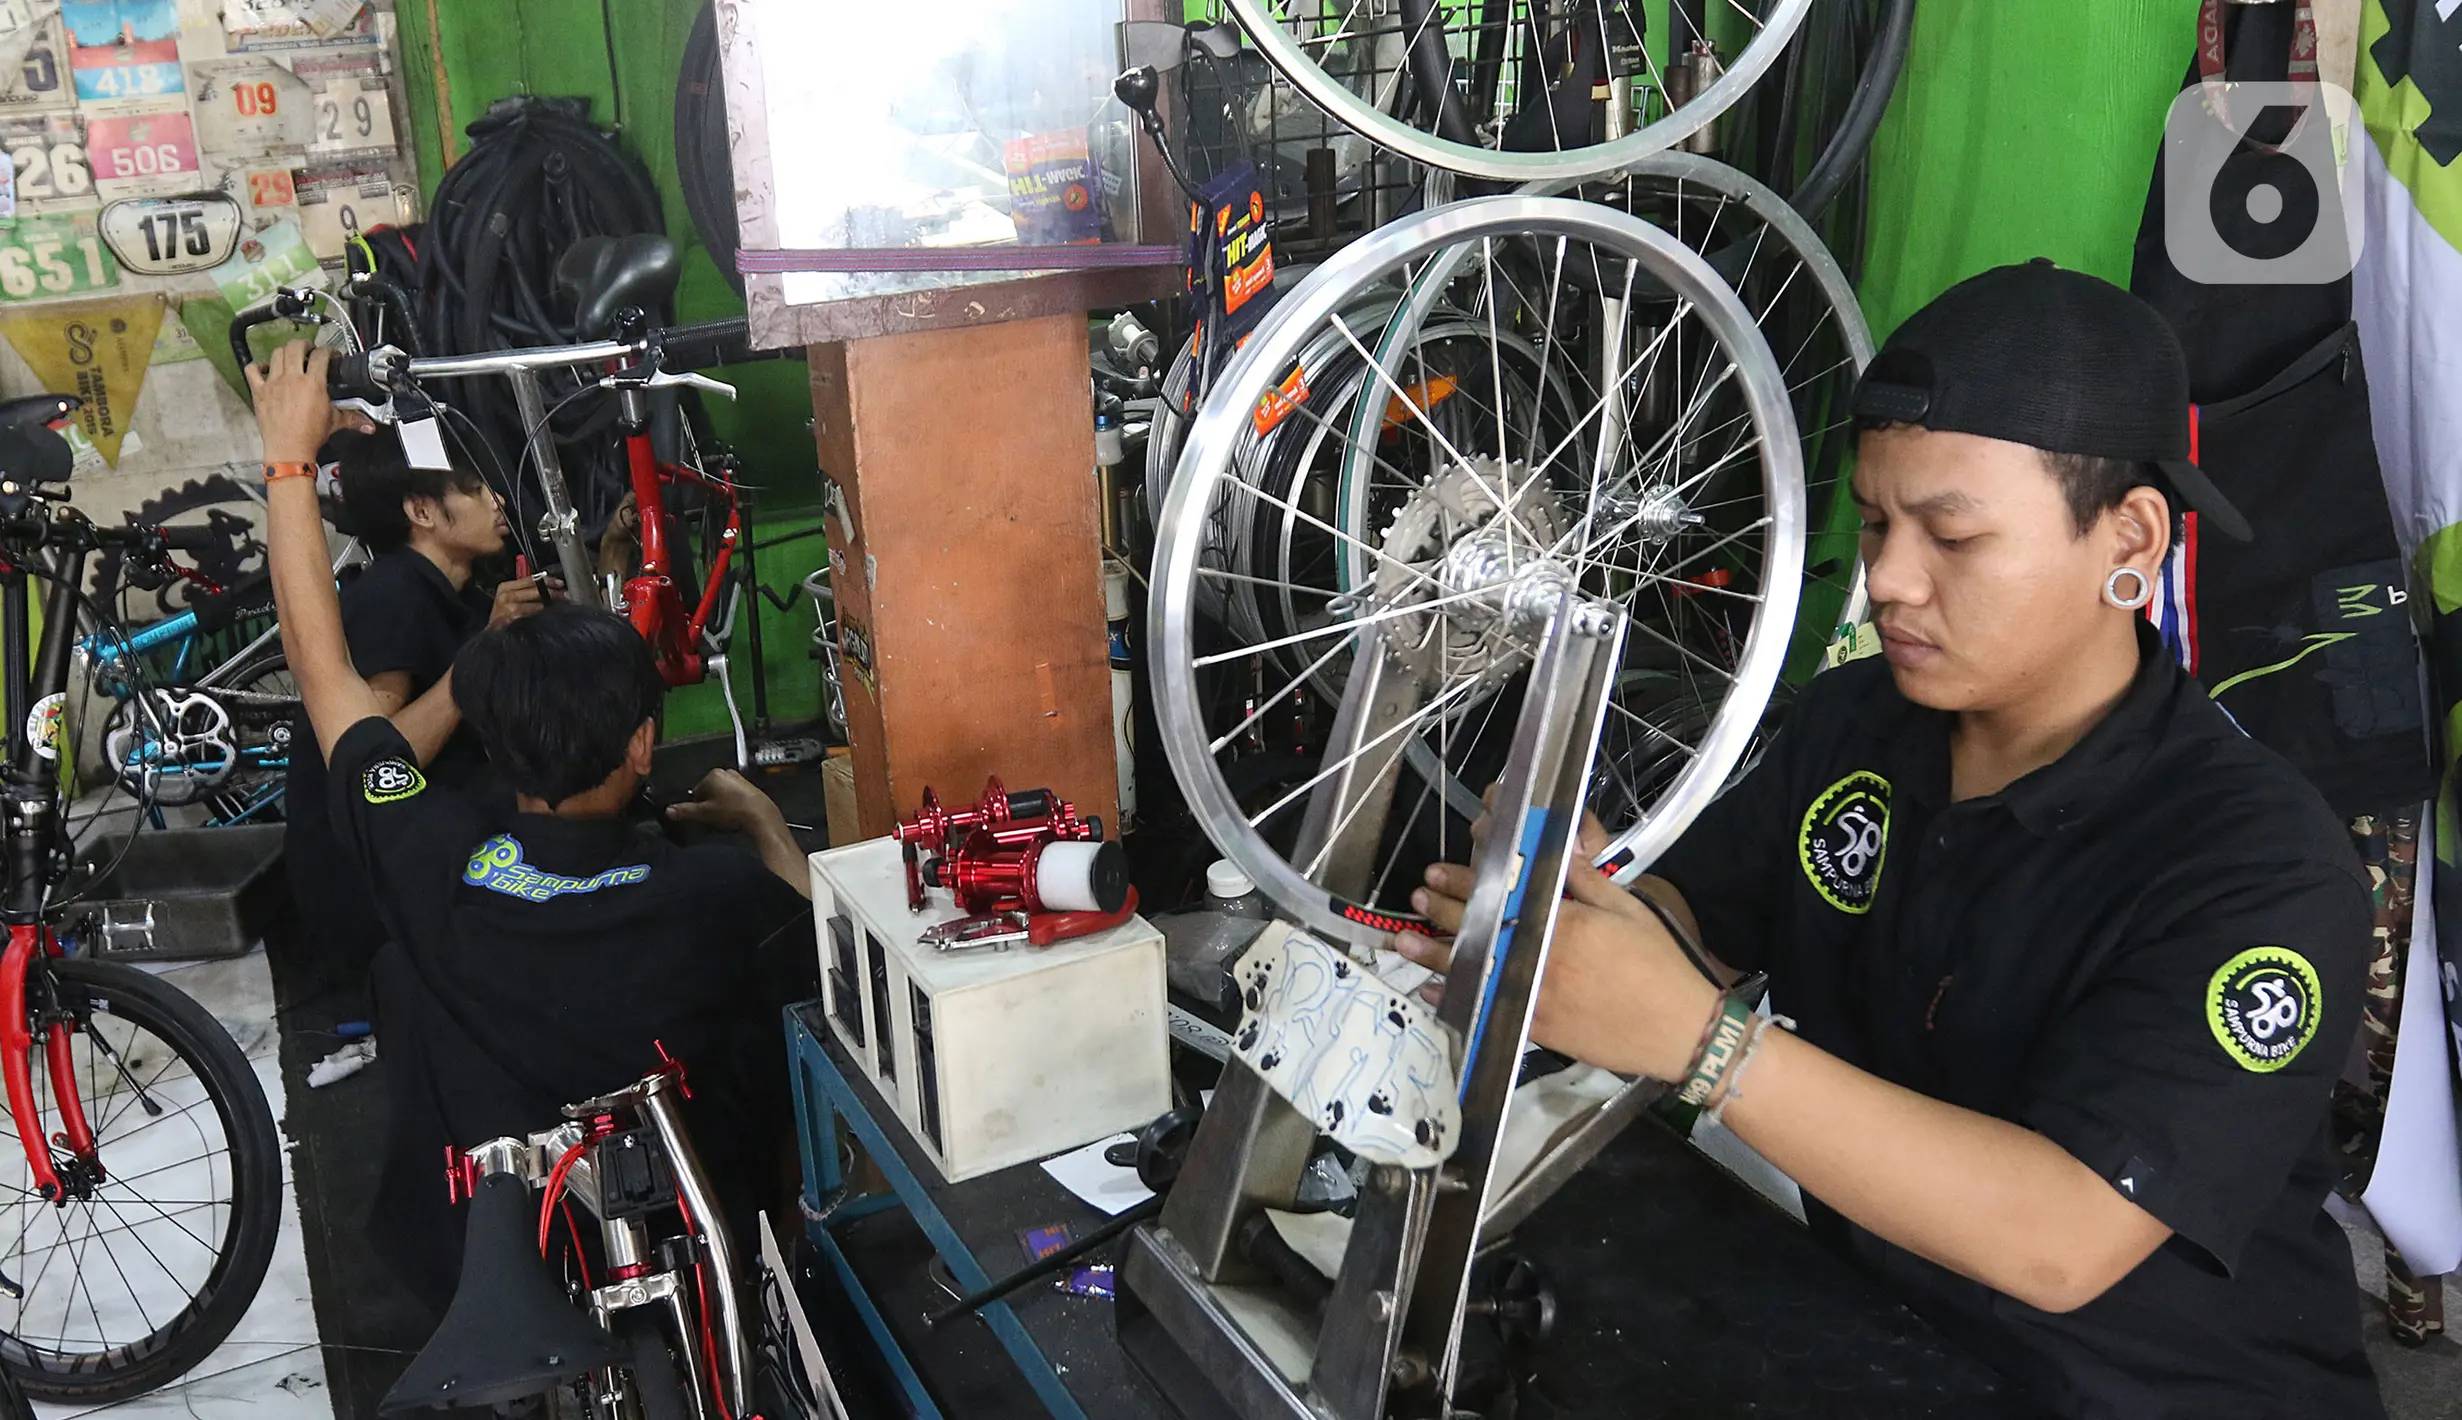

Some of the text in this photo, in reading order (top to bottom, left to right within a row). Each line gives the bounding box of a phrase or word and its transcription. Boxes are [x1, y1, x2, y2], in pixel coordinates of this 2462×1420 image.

[96, 64, 162, 97] 418
[235, 82, 277, 117] 09
[12, 142, 90, 198] 26
[112, 144, 181, 177] 506
[251, 171, 294, 206] 29
[137, 209, 211, 261] 175
[0, 237, 106, 297] 651
[237, 253, 304, 301] 311
[1813, 838, 1863, 898] SAMPURNA
[2224, 998, 2297, 1058] SAMPURNA BIKE
